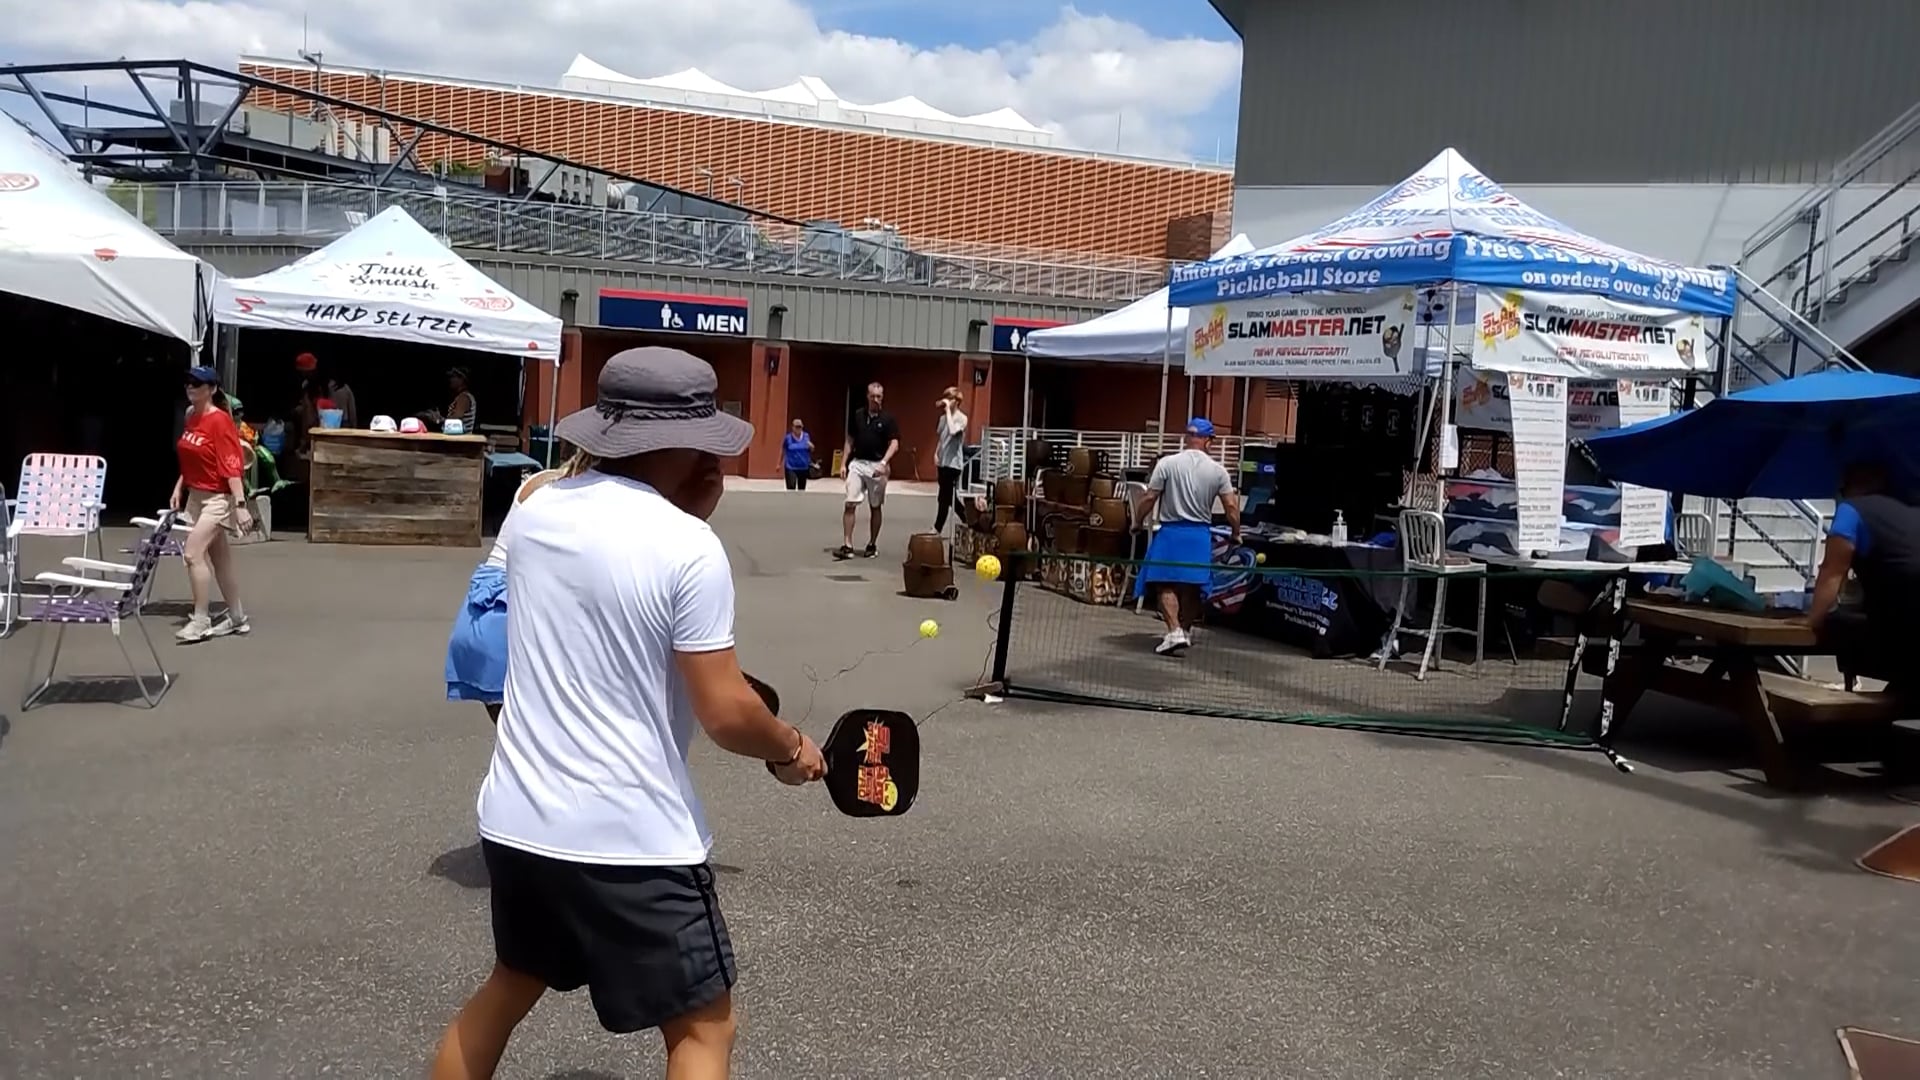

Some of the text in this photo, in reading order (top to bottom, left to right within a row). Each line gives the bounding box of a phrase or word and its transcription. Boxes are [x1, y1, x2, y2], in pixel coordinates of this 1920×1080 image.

[1347, 240, 1452, 261] Growing
[1465, 234, 1524, 260] Free
[1217, 267, 1381, 297] Pickleball Store
[1521, 271, 1547, 285] on
[1550, 271, 1609, 289] orders
[1613, 279, 1651, 297] over
[305, 303, 476, 338] HARD SELTZER
[696, 313, 744, 333] MEN
[1228, 315, 1386, 339] SLAMMASTER.NET
[1523, 313, 1677, 345] SLAMMASTER.NET
